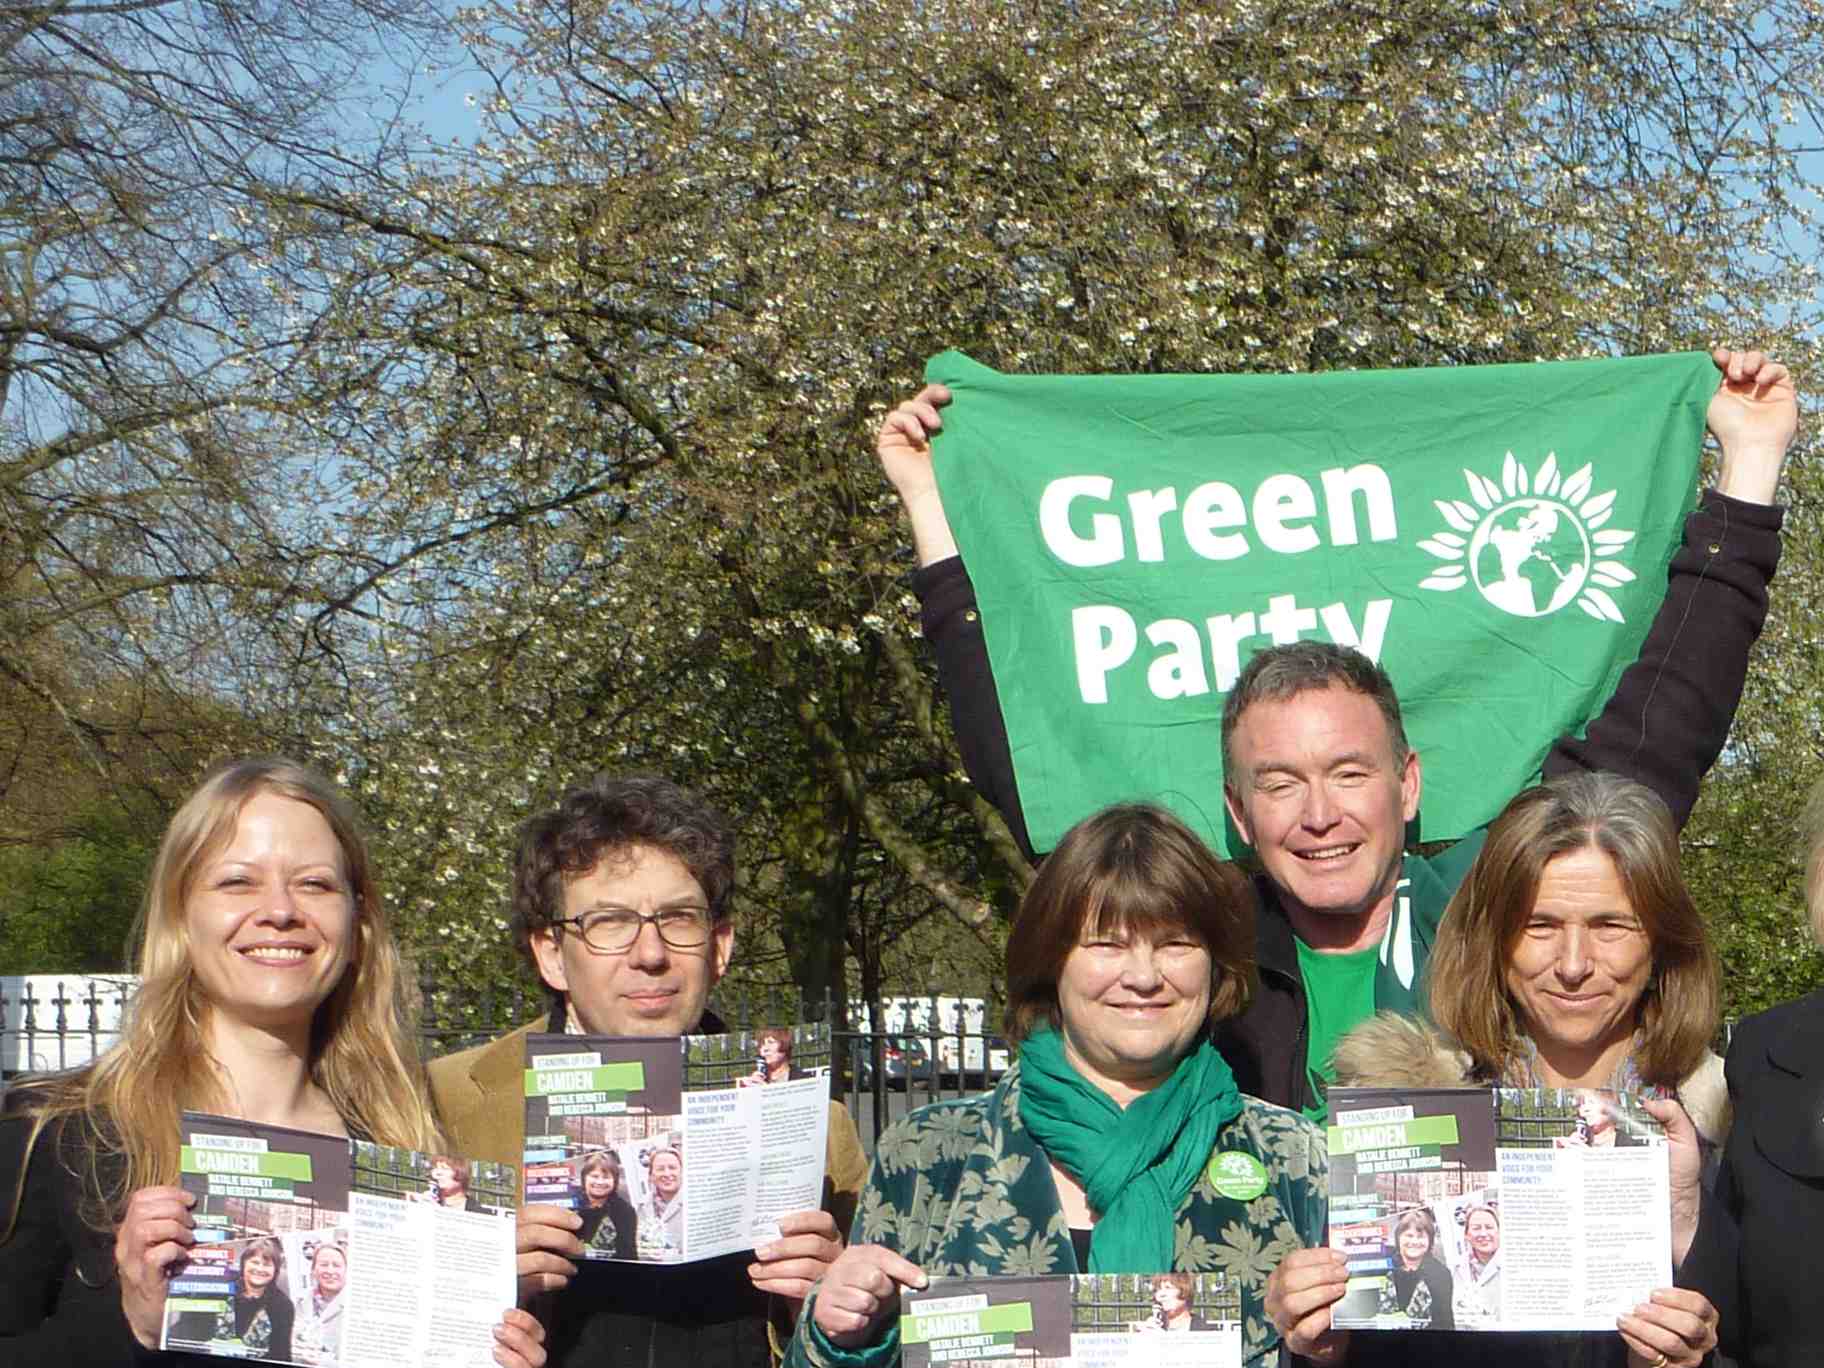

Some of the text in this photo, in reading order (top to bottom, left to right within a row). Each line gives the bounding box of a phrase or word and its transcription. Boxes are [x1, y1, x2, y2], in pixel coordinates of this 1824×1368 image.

[1038, 463, 1399, 567] Green
[537, 1071, 593, 1092] CAMDEN
[1342, 1123, 1406, 1148] CAMDEN
[195, 1150, 260, 1173] CAMDEN
[916, 1314, 978, 1341] CAMDEN
